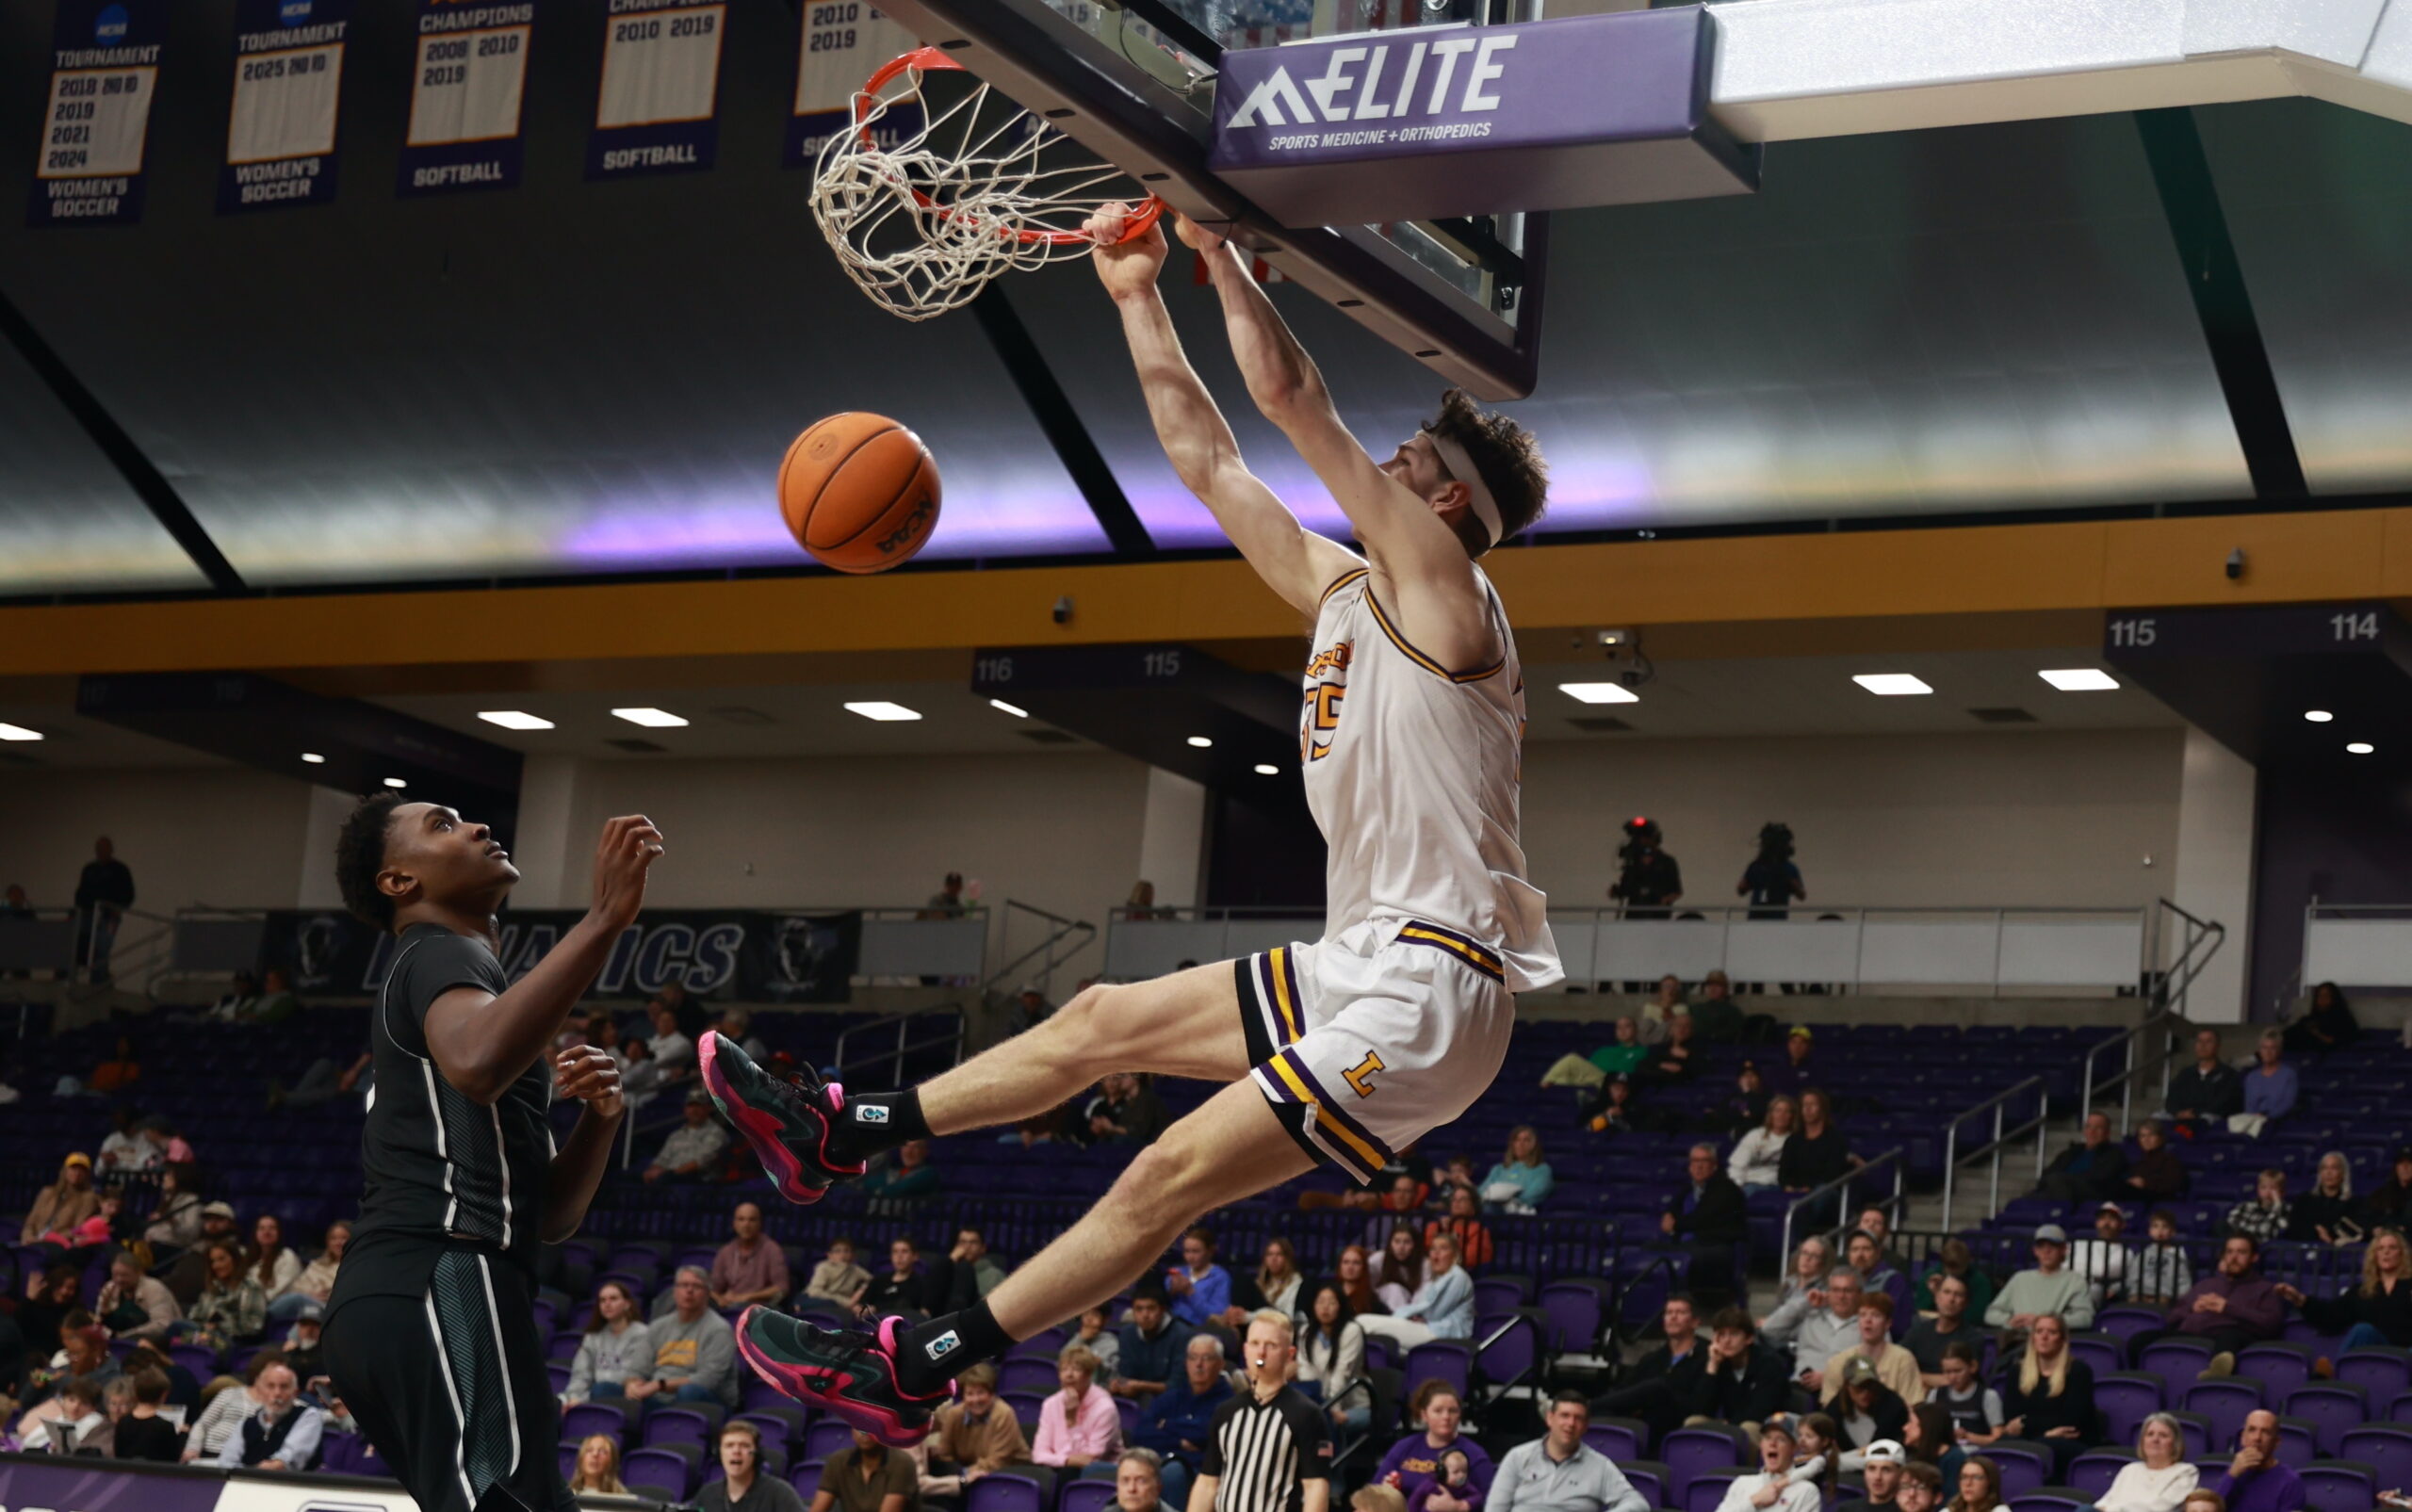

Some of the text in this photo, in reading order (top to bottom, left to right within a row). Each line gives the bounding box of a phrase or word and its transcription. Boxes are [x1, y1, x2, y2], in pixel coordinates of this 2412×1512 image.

[419, 4, 533, 33] CHAMPIONS
[814, 5, 858, 25] 2010
[238, 21, 347, 52] TOURNAMENT
[616, 15, 714, 41] 2010 2019
[479, 35, 518, 57] 2010
[810, 30, 856, 51] 2019
[56, 44, 161, 68] TOURNAMENT
[244, 59, 285, 81] 2025
[424, 66, 464, 87] 2019
[1304, 35, 1519, 122] ELITE
[59, 77, 96, 97] 2018
[56, 101, 94, 121] 2019
[52, 125, 90, 144] 2021
[1269, 135, 1318, 150] SPORTS
[1321, 130, 1387, 148] MEDICINE
[1399, 122, 1491, 142] ORTHOPEDICS
[48, 150, 87, 168] 2024
[603, 144, 697, 171] SOFTBALL
[236, 157, 320, 185] WOMEN'S
[414, 161, 503, 187] SOFTBALL
[47, 178, 128, 199] WOMEN'S
[241, 178, 312, 203] SOCCER
[52, 197, 120, 218] SOCCER
[2110, 620, 2156, 646] 115
[2330, 612, 2379, 641] 114
[978, 657, 1013, 681] 116
[1144, 652, 1180, 676] 115
[1341, 1049, 1386, 1098] L
